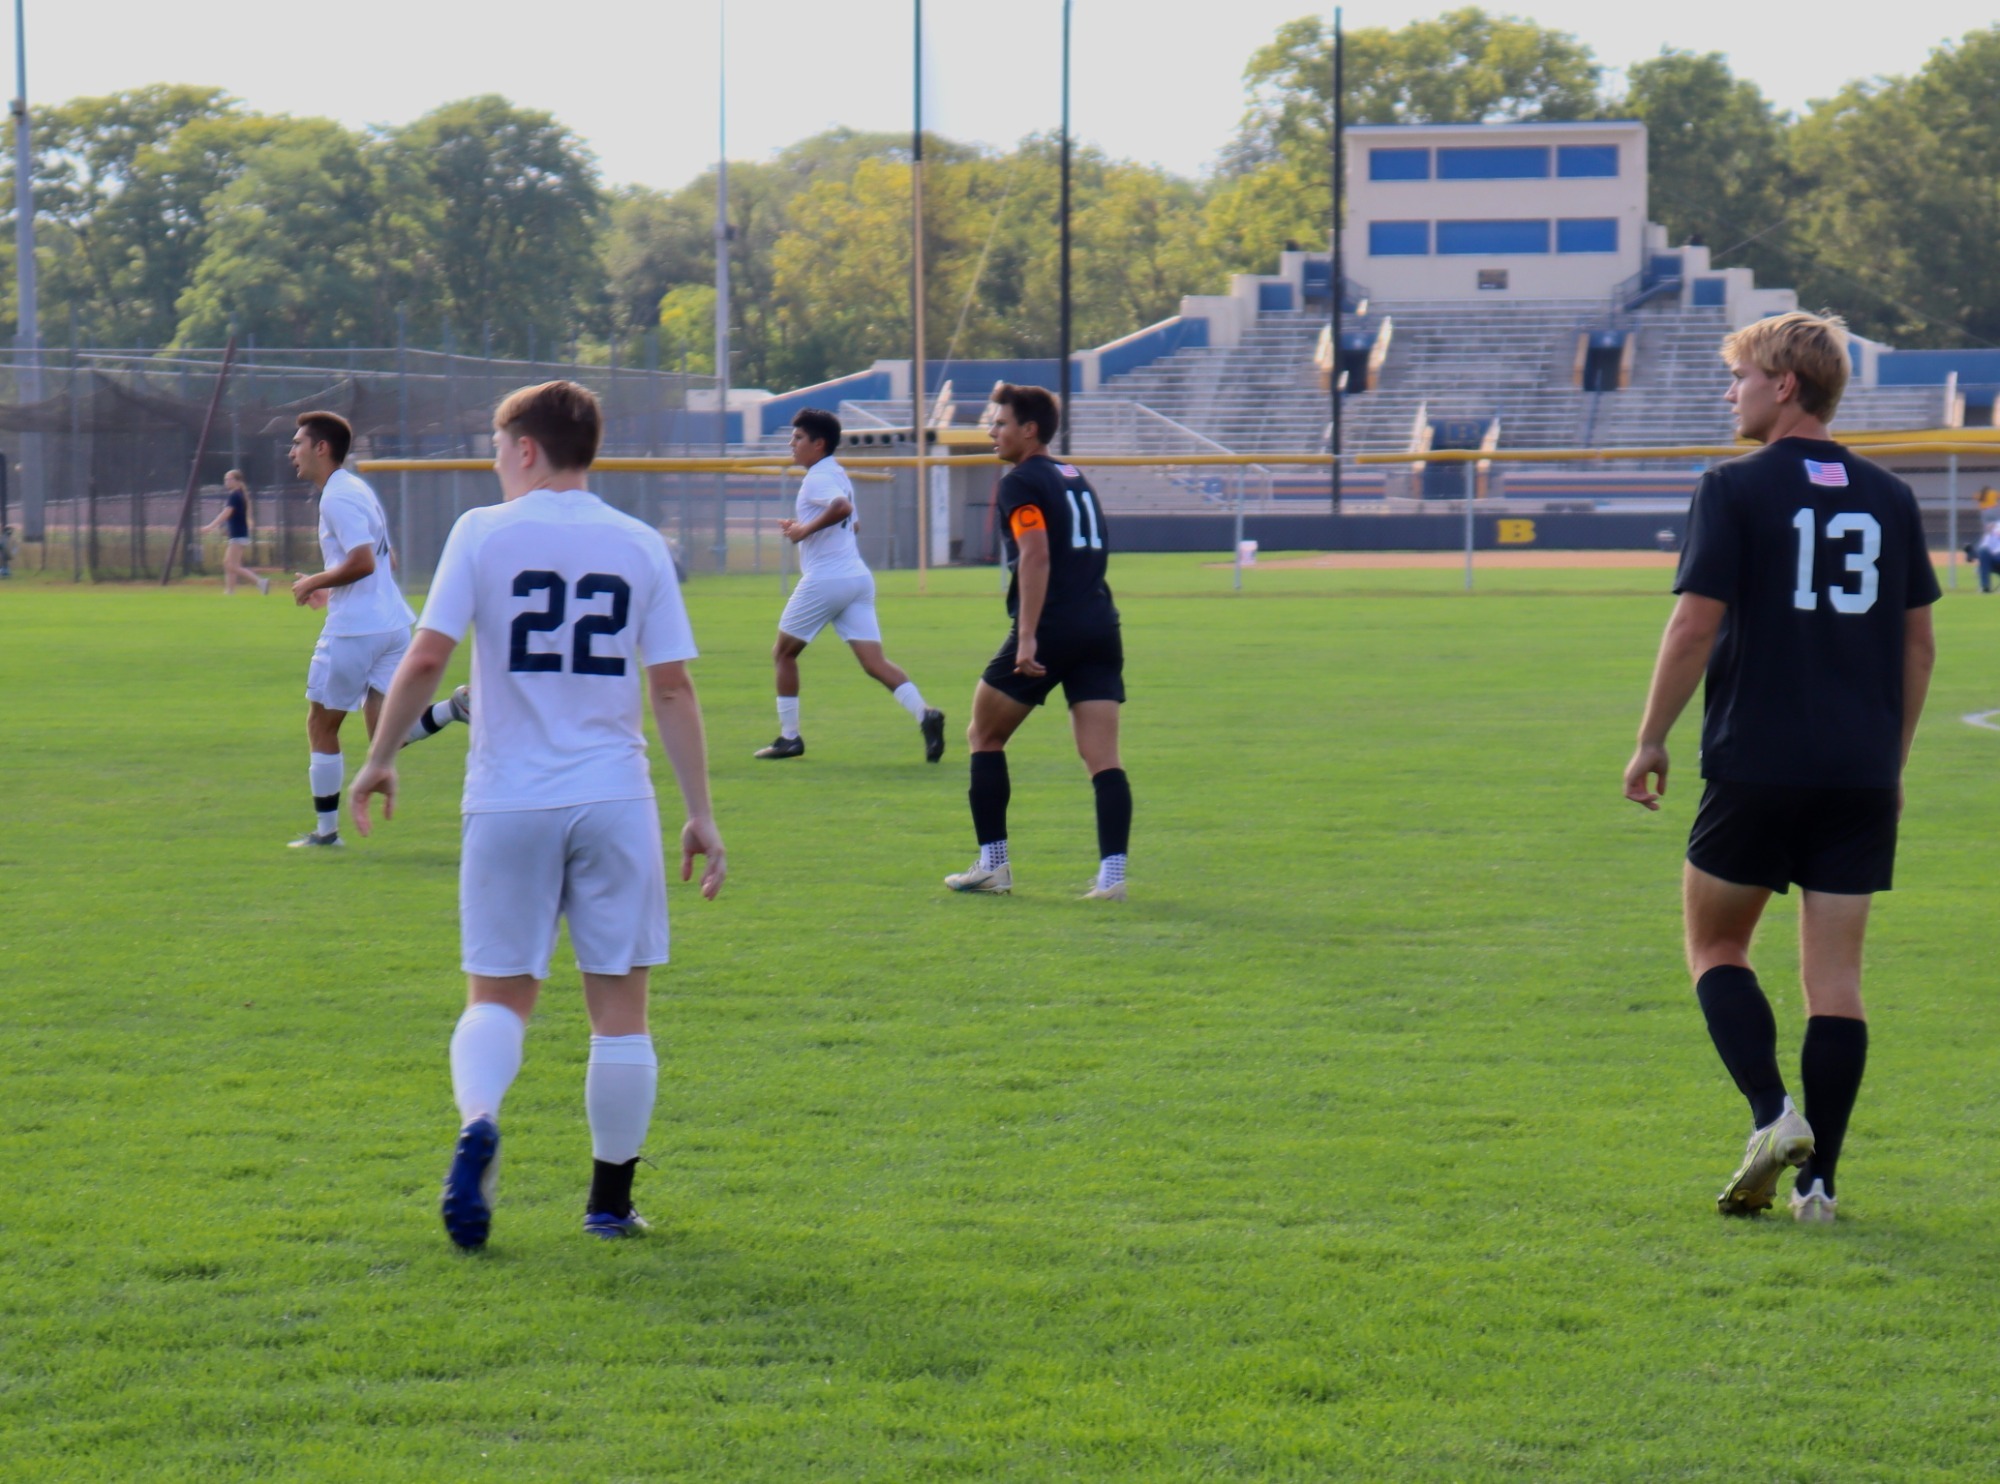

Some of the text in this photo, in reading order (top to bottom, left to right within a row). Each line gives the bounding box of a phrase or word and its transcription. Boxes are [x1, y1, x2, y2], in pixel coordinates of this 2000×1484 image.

[1019, 507, 1038, 527] C
[1066, 490, 1102, 549] 11
[1498, 519, 1536, 543] B
[1793, 507, 1881, 614] 13
[509, 570, 631, 676] 22
